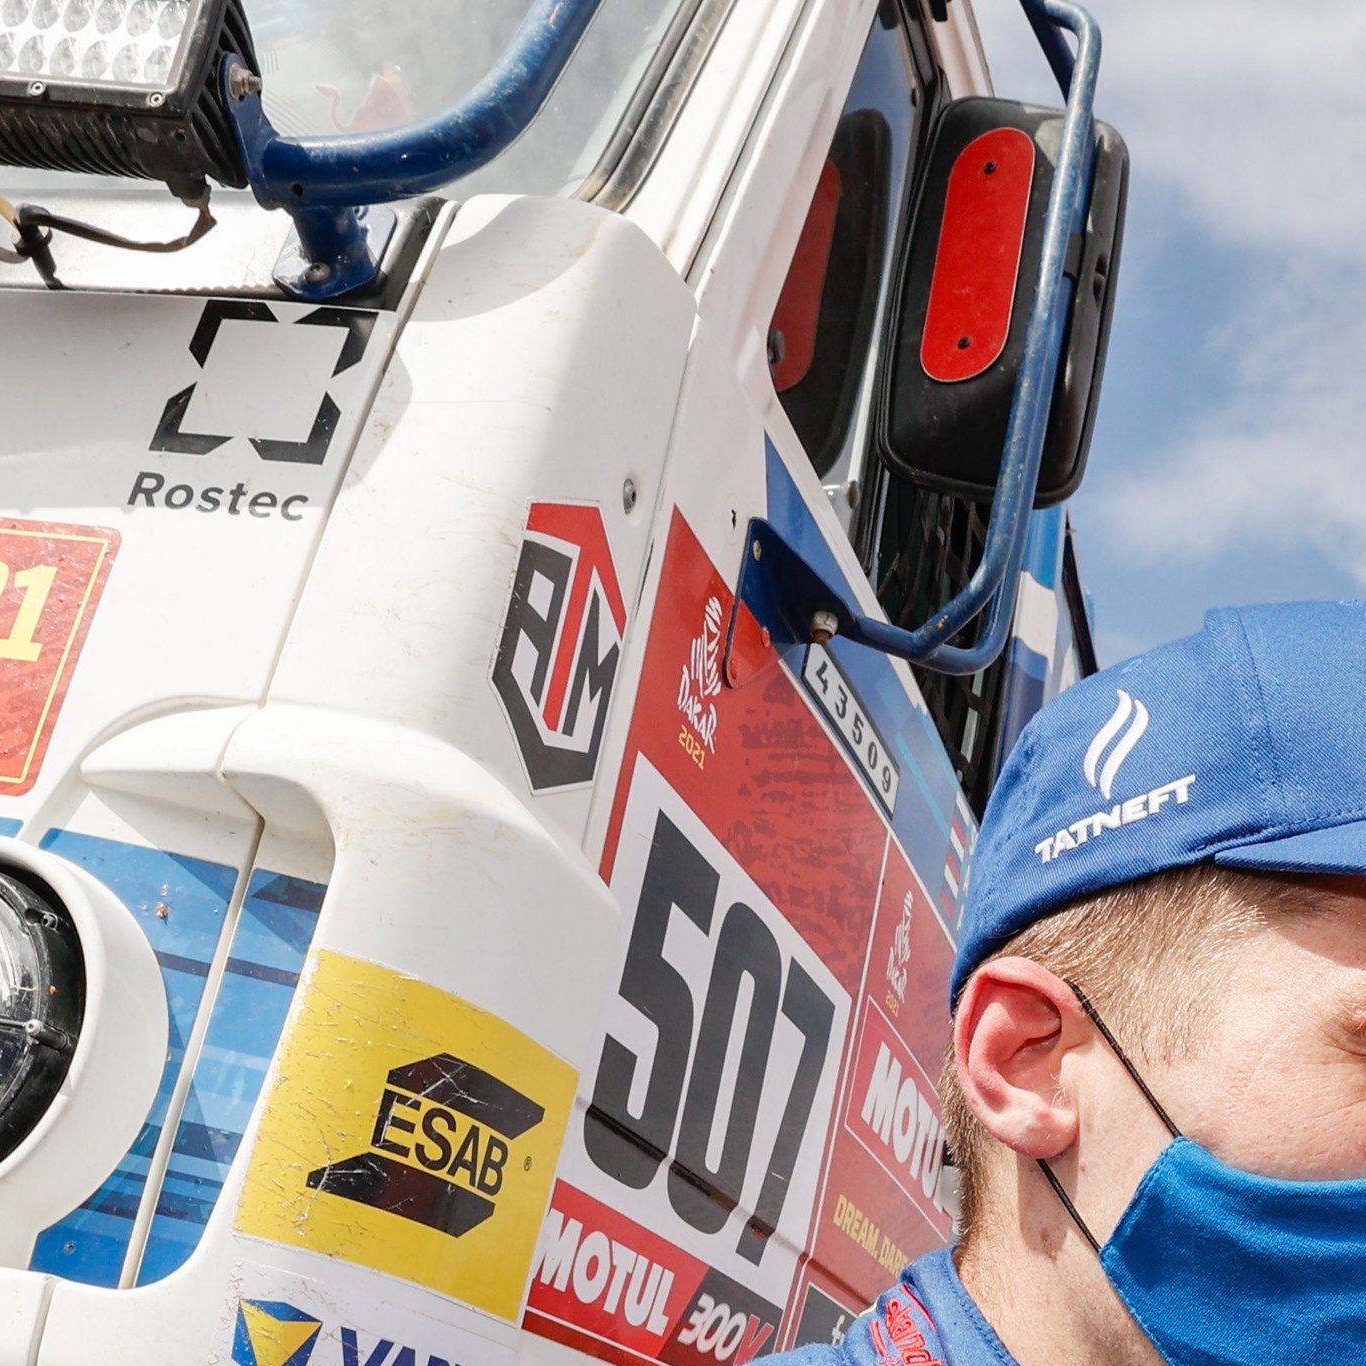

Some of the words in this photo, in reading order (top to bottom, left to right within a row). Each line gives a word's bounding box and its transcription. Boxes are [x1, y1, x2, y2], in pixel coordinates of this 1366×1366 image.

[126, 471, 311, 523] Rostec
[676, 663, 719, 756] DAKAR
[677, 723, 707, 771] 2021
[816, 658, 894, 796] 43509
[1034, 774, 1197, 866] TATNEFT
[582, 807, 836, 1267] 507
[371, 1089, 511, 1198] ESAB
[524, 1207, 676, 1338] MOTUL
